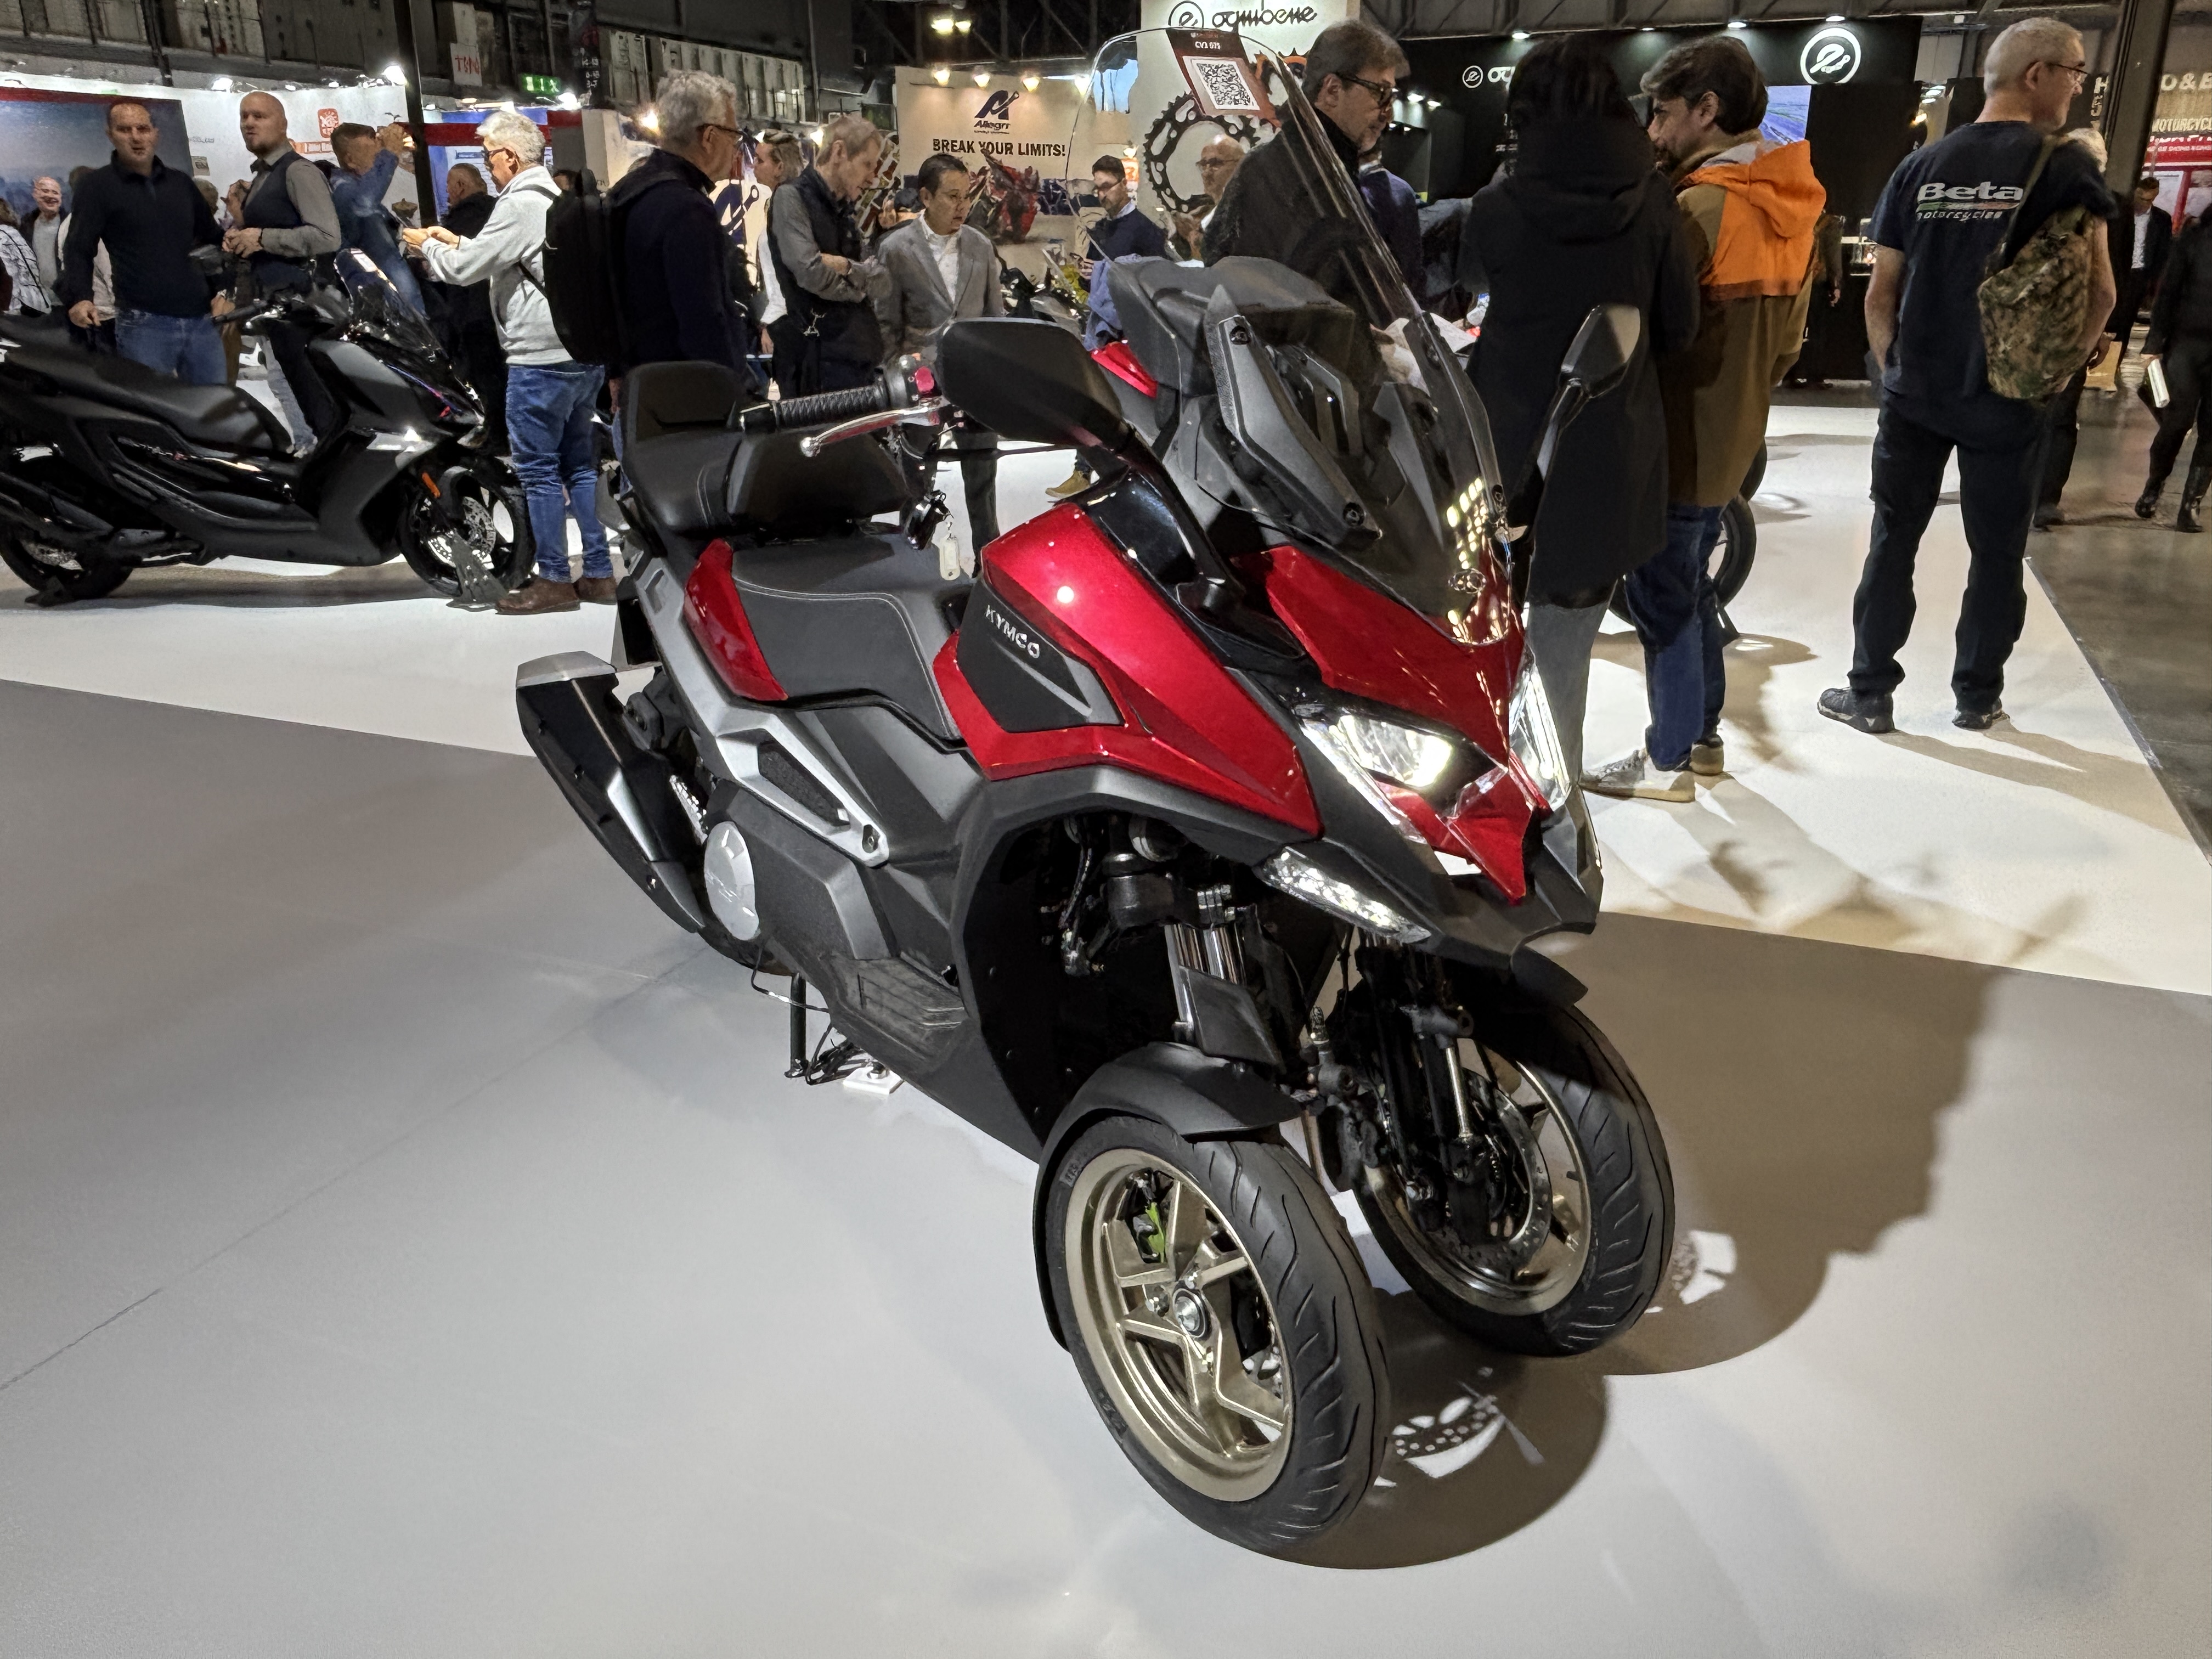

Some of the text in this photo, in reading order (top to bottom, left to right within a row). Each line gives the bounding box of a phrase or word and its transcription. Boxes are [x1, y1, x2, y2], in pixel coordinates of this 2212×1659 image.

[933, 138, 1065, 157] BREAK YOUR LIMITS!
[1917, 181, 2024, 201] Beta
[985, 605, 1040, 658] KYMCO
